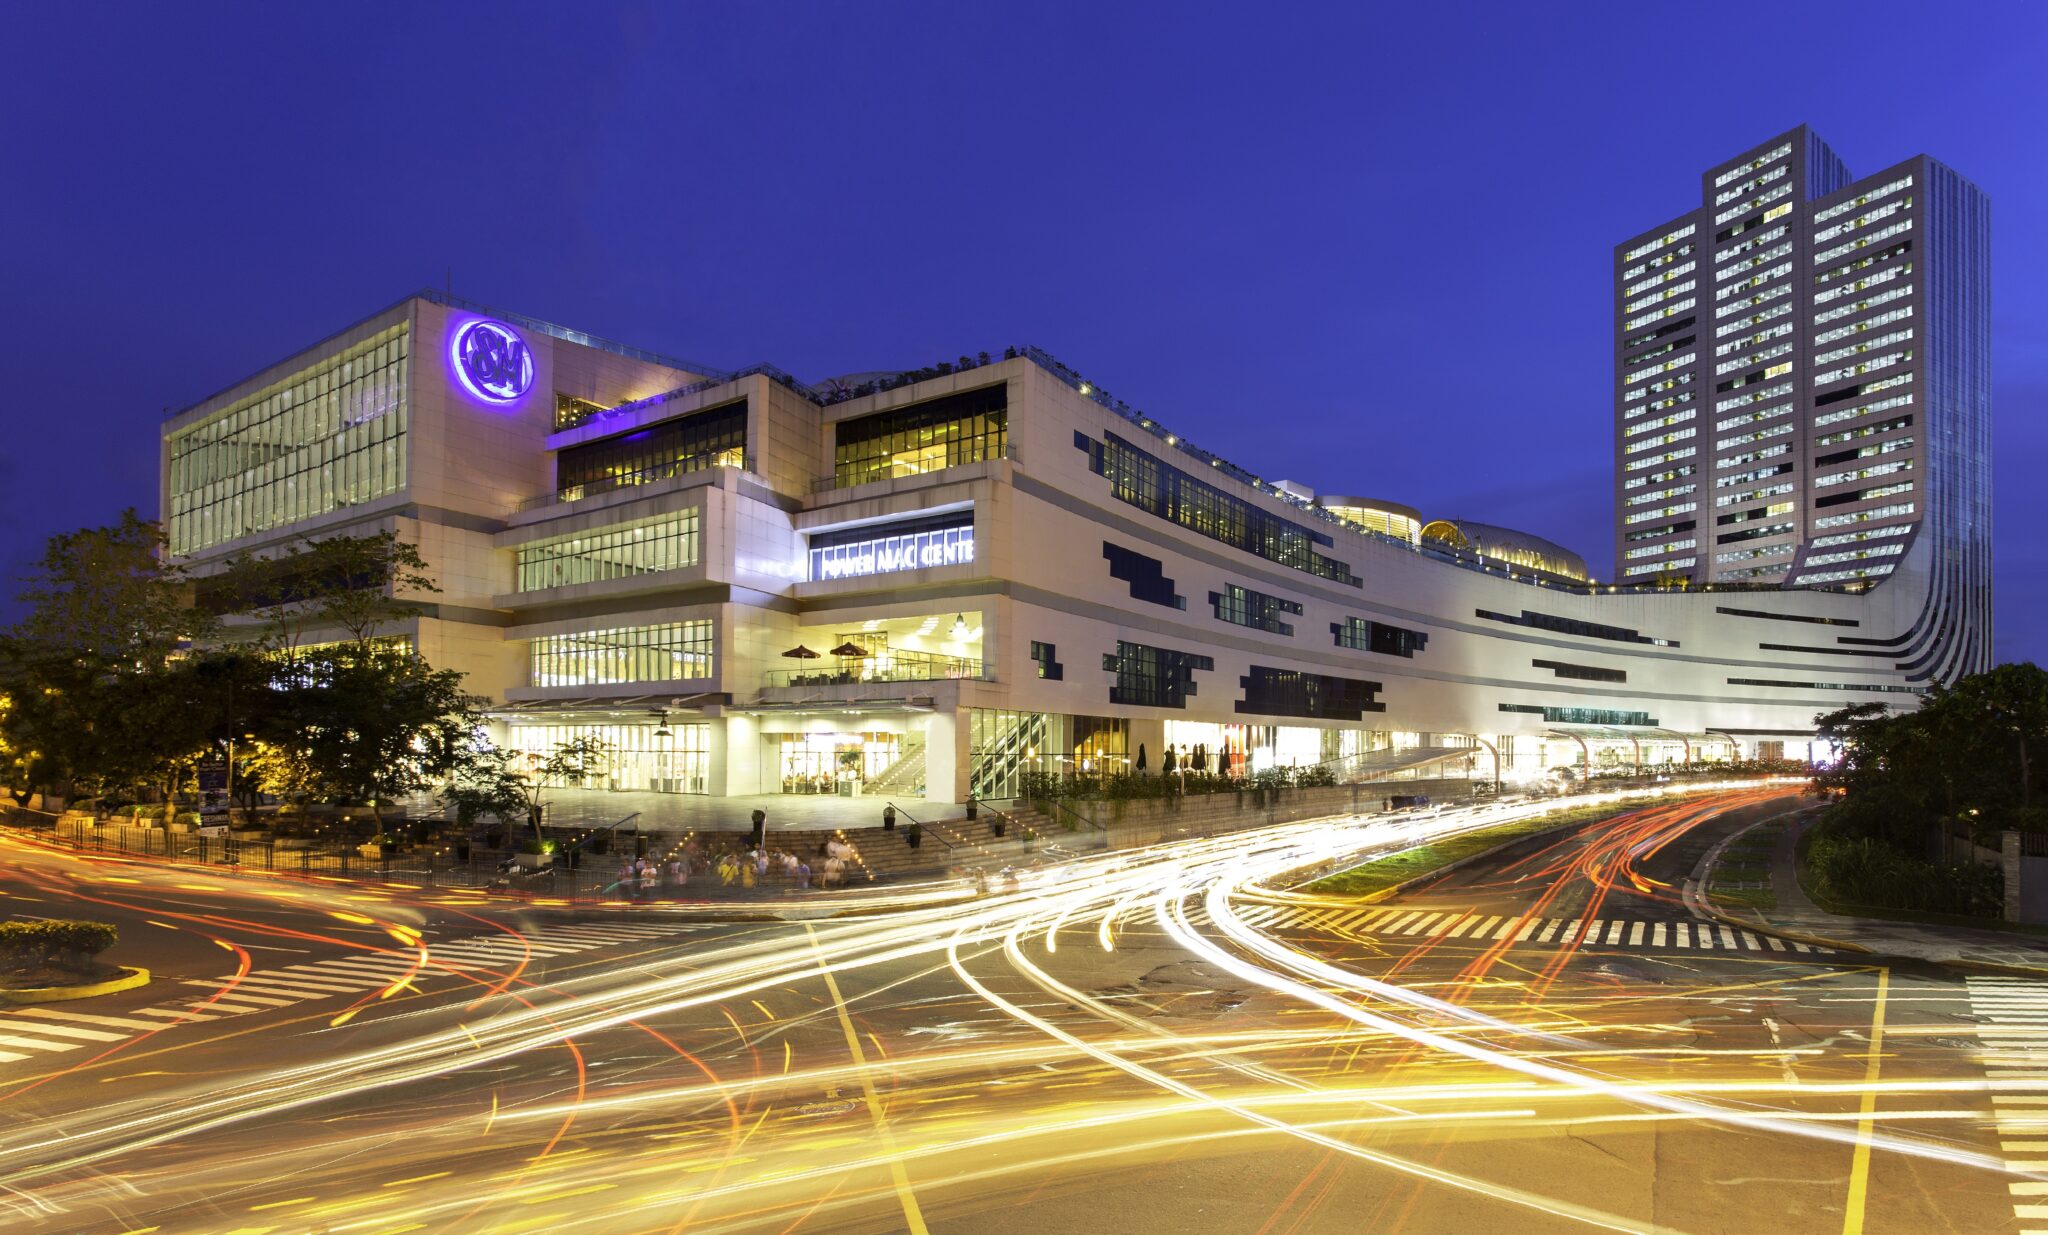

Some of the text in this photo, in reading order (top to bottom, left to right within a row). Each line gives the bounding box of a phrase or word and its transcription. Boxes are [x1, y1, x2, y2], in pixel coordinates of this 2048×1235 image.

[470, 326, 524, 393] SM
[823, 539, 974, 577] POWER MAC CENTE
